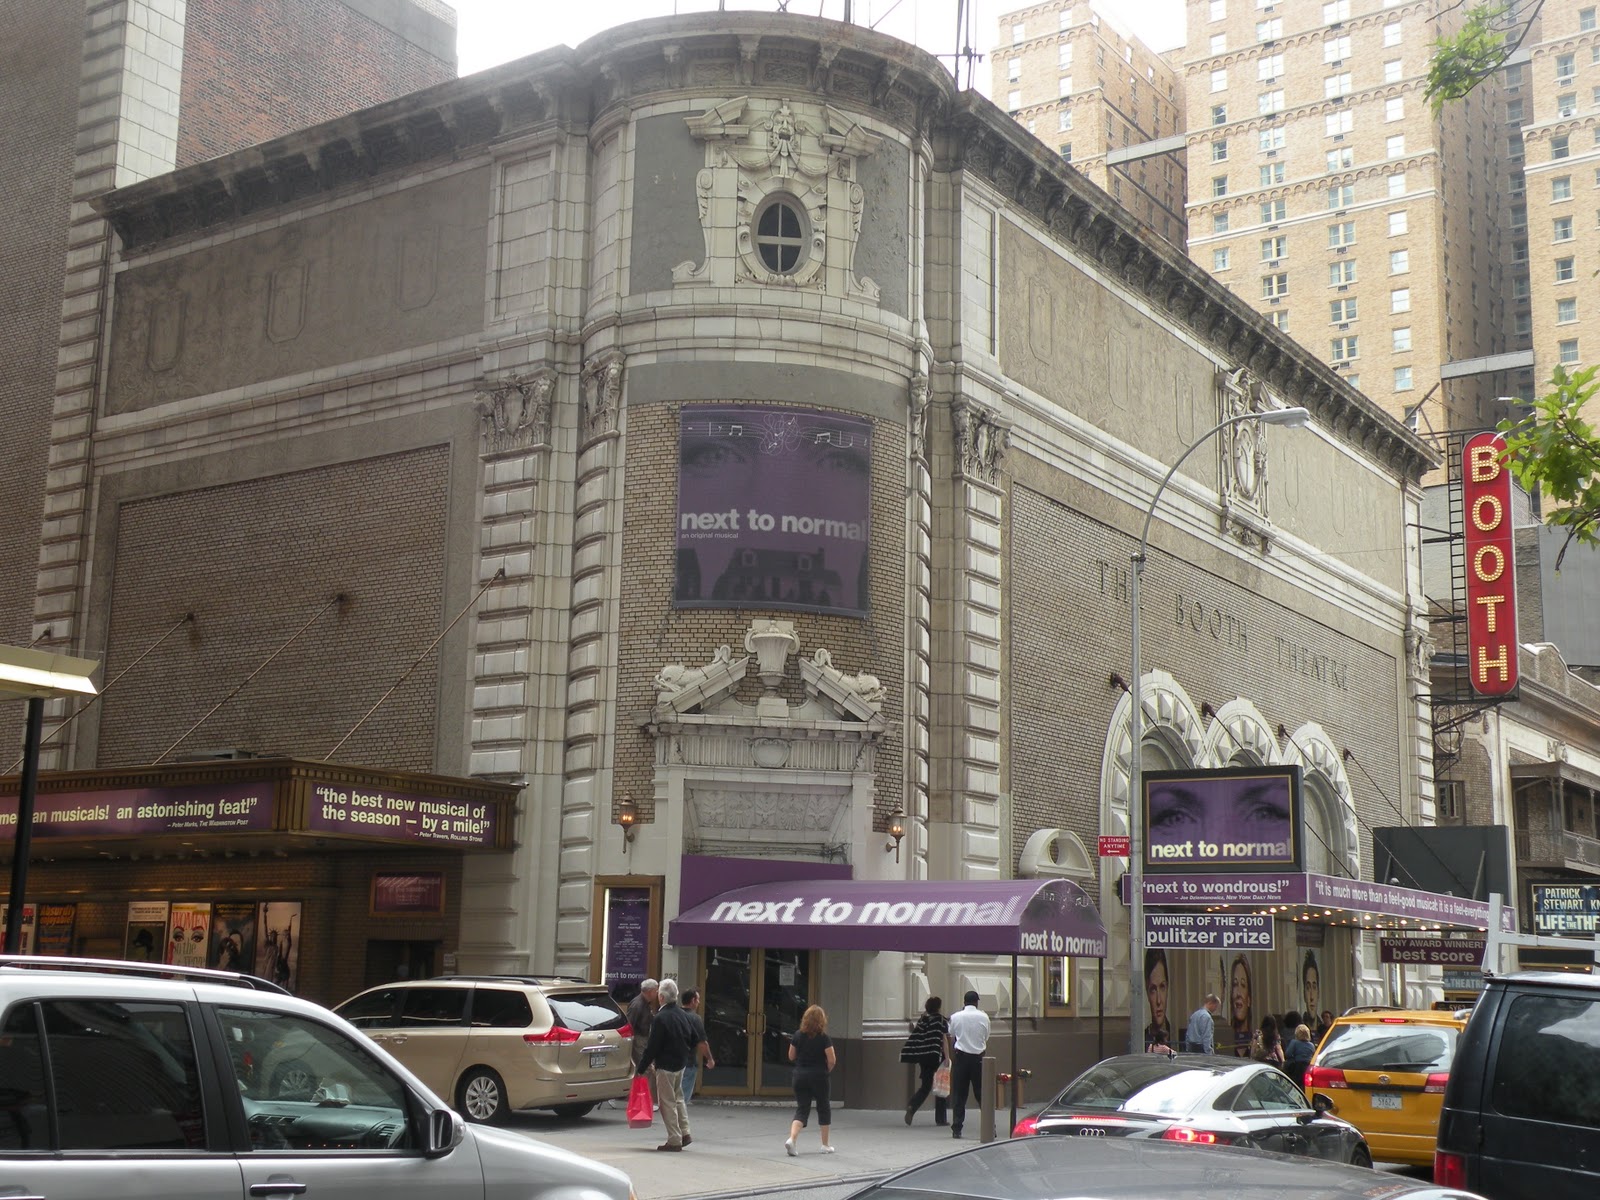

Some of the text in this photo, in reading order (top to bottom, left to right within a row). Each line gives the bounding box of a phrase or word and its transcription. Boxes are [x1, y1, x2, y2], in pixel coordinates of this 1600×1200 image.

[681, 508, 866, 541] next to normal
[690, 531, 713, 540] original
[1471, 445, 1508, 683] BOOTH
[1175, 592, 1248, 651] BOOTH
[1275, 636, 1348, 691] THEATRE
[51, 804, 109, 823] musicals!
[116, 807, 132, 819] an
[137, 800, 214, 819] astonishing
[316, 786, 486, 819] “the best new musical of
[322, 804, 346, 821] the
[350, 810, 400, 827] season
[422, 815, 436, 833] by
[441, 820, 449, 831] a
[1151, 838, 1291, 858] next to normal
[1182, 882, 1197, 893] to
[1545, 887, 1581, 899] PATRICK
[1325, 882, 1332, 896] is
[1333, 885, 1350, 899] much
[1352, 889, 1368, 902] more
[1368, 888, 1383, 903] than
[1383, 893, 1388, 904] a
[1388, 891, 1416, 909] feel-good
[1438, 900, 1443, 912] it
[1444, 900, 1449, 913] is
[1449, 904, 1453, 914] a
[1543, 899, 1584, 911] STEWART
[710, 894, 1021, 926] next to normal
[172, 911, 208, 931] WOMEN
[1151, 916, 1264, 926] WINNER OF THE 2010
[1539, 914, 1566, 930] LIFE
[1566, 921, 1577, 929] THE
[1020, 929, 1106, 956] next to normal
[1147, 928, 1271, 946] pulitzer prize
[1383, 938, 1484, 949] TONY AWARD WINNER!
[1392, 948, 1475, 963] best score
[605, 971, 619, 980] next
[620, 972, 627, 980] to
